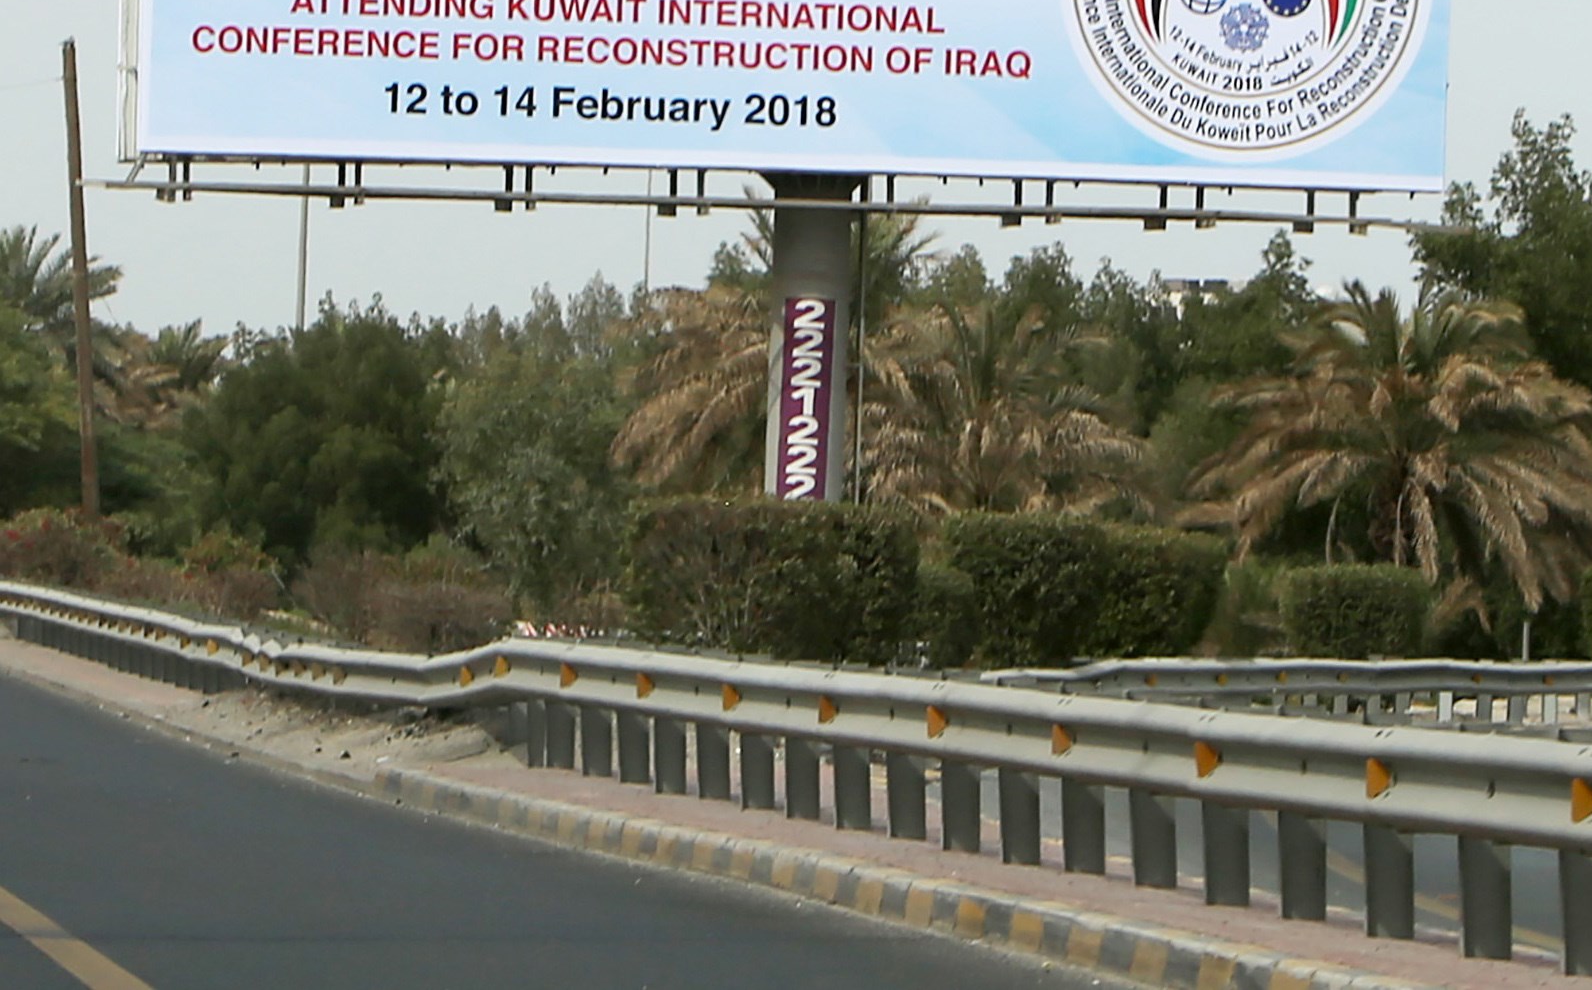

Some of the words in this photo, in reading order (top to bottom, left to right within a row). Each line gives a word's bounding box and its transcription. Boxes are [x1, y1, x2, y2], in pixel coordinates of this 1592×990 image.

[192, 25, 439, 59] CONFERENCE
[452, 33, 524, 61] FOR
[537, 35, 873, 72] RECONSTRUCTION
[885, 46, 933, 74] OF
[945, 49, 1031, 79] IRAQ
[1169, 82, 1261, 119] Conference
[1267, 99, 1293, 117] For
[1297, 6, 1386, 108] Reconstruction
[1172, 52, 1218, 85] KUWAIT
[1222, 75, 1263, 91] 2018
[1196, 45, 1242, 73] February
[384, 81, 428, 115] 12
[440, 84, 479, 116] to
[493, 84, 537, 118] 14
[552, 85, 731, 132] February
[744, 93, 837, 128] 2018
[1093, 25, 1168, 117] Internationale
[1170, 108, 1192, 129] Du
[1255, 121, 1292, 141] Pour
[1296, 114, 1317, 131] La
[1317, 20, 1403, 121] Reconstruction
